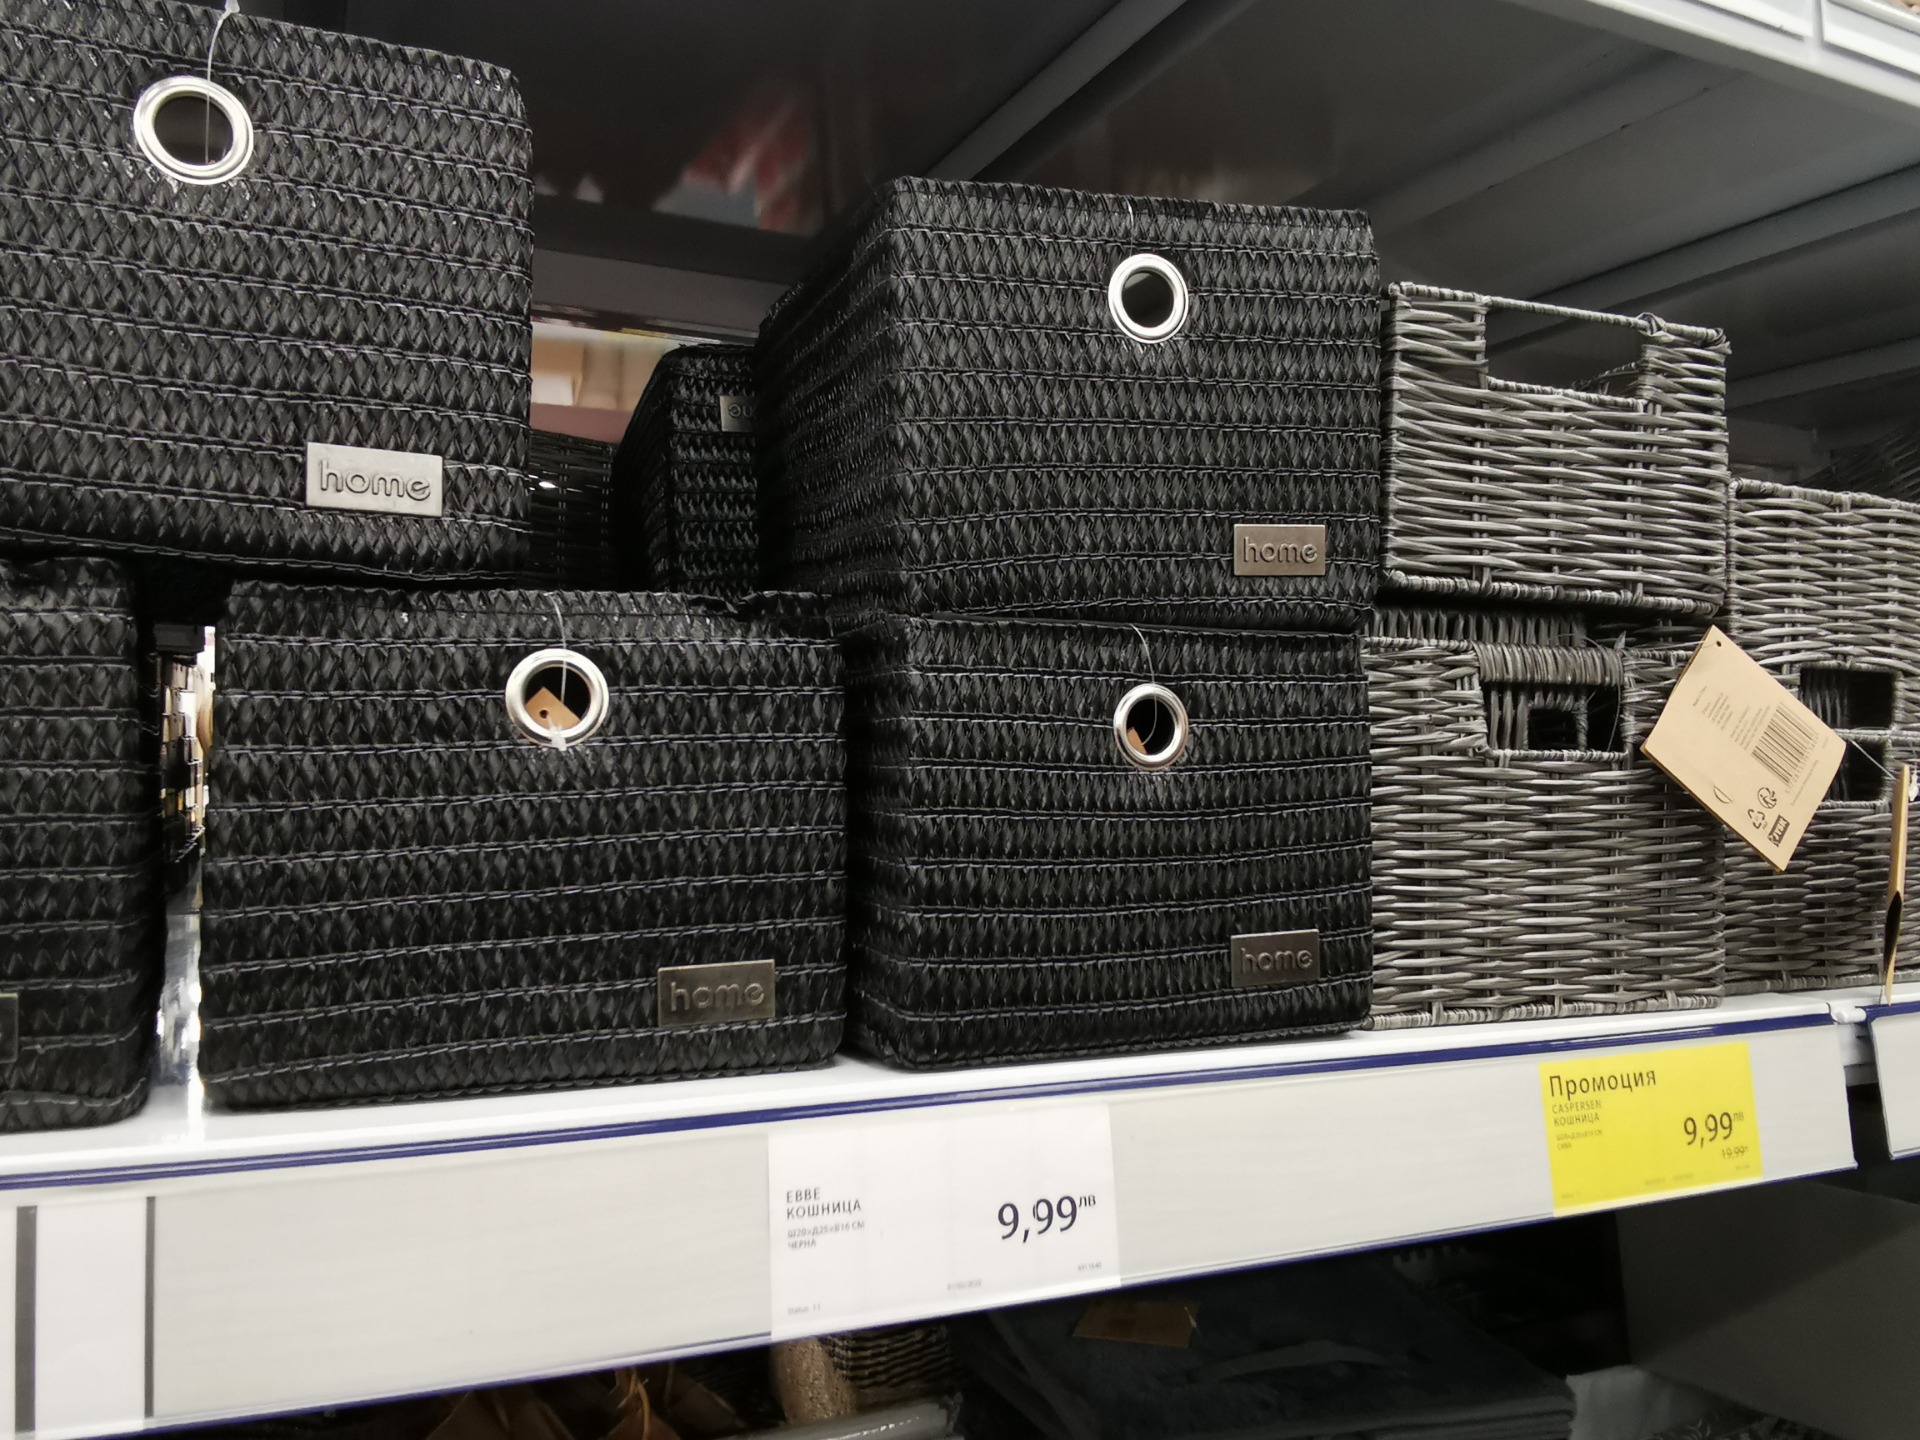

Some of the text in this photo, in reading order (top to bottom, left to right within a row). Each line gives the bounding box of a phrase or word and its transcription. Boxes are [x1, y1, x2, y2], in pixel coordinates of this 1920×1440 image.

[319, 458, 432, 502] home
[1242, 535, 1319, 565] home
[1240, 946, 1313, 975] home
[669, 981, 766, 1011] home
[1548, 1070, 1657, 1101] Промоция
[1551, 1099, 1602, 1115] CASPERSEN
[1553, 1112, 1601, 1127] КОШНИЦА
[1683, 1111, 1733, 1149] 9,99
[786, 1198, 862, 1221] КОШНИЦА
[997, 1195, 1078, 1243] 9,99
